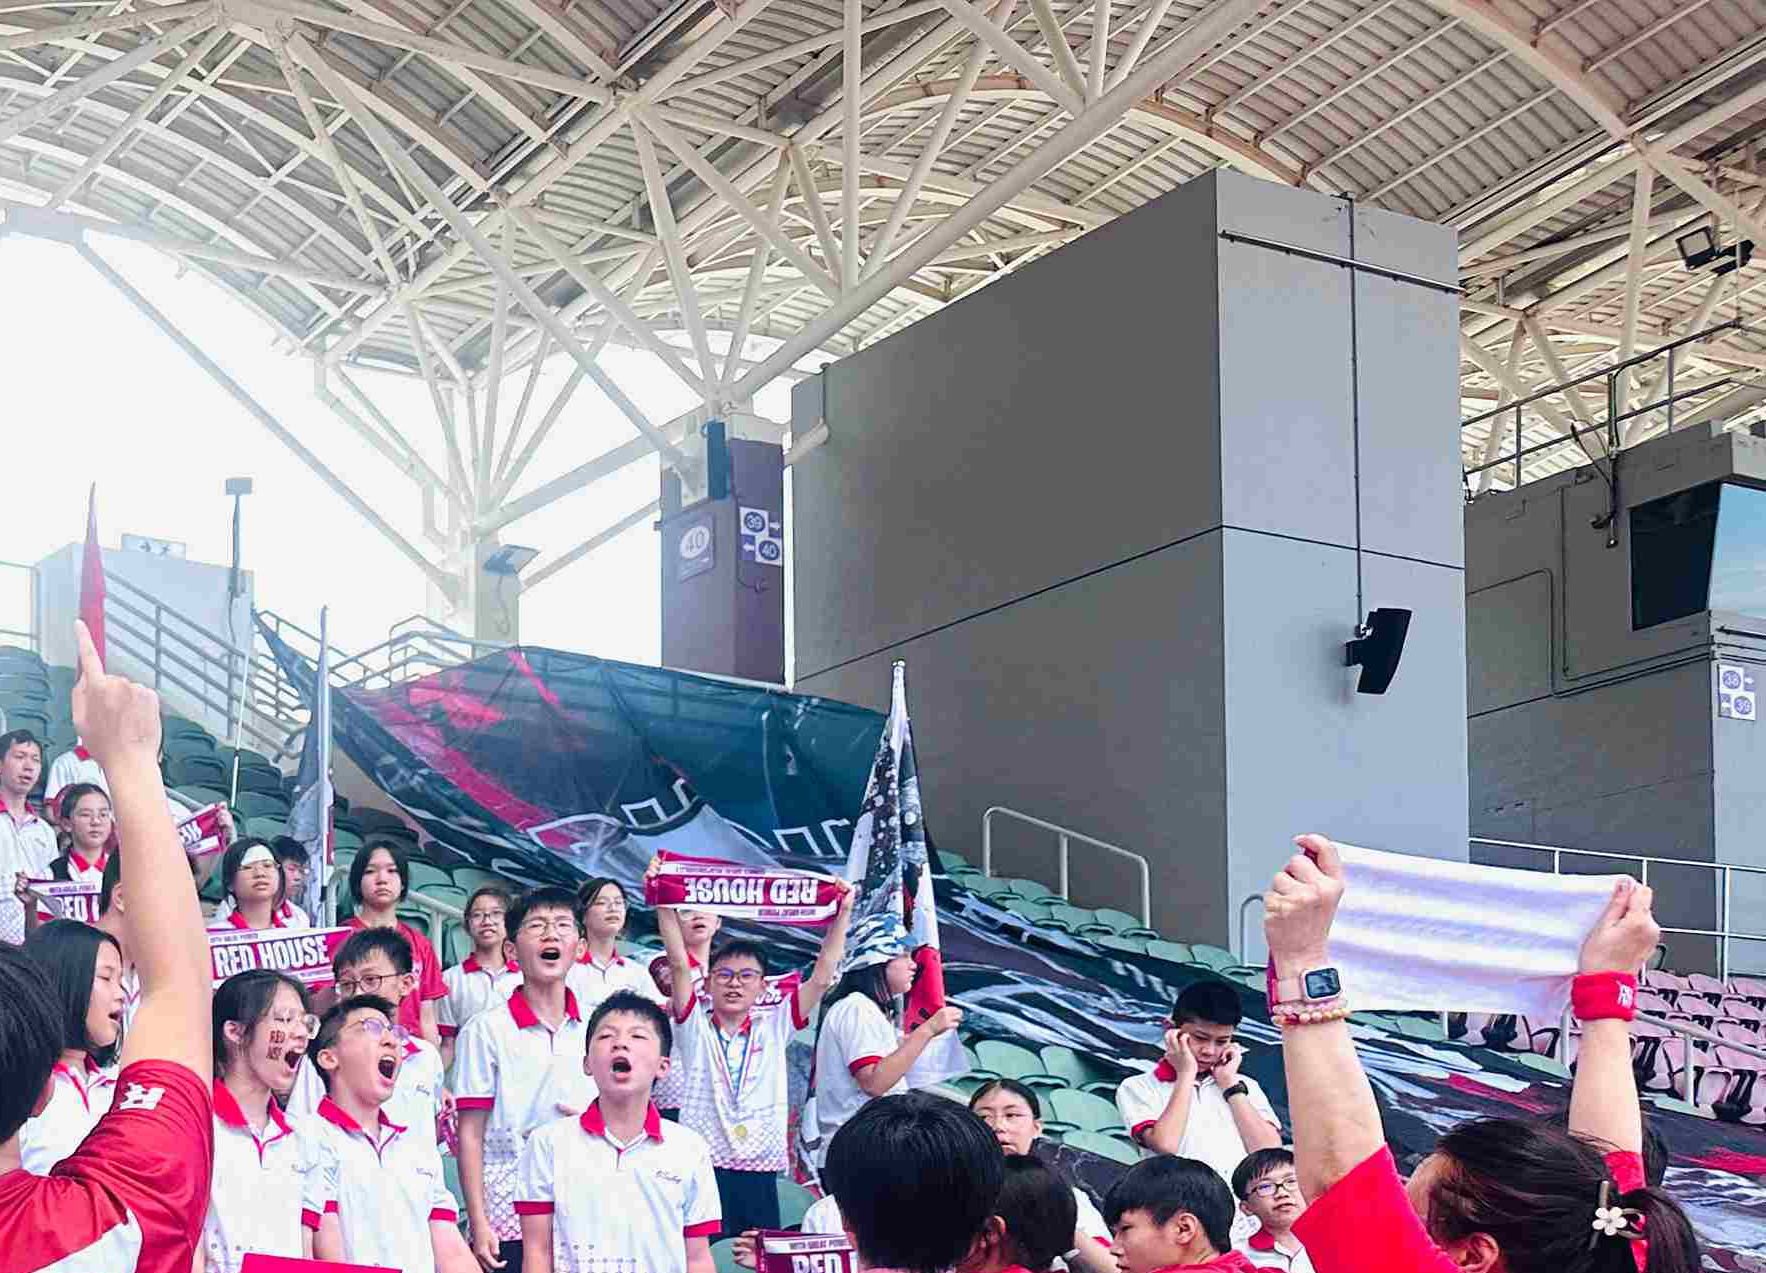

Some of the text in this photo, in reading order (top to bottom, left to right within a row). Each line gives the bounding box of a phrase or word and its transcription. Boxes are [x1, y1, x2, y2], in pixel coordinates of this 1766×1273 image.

[683, 877, 819, 905] RED HOUSE
[213, 935, 331, 977] RED HOUSE
